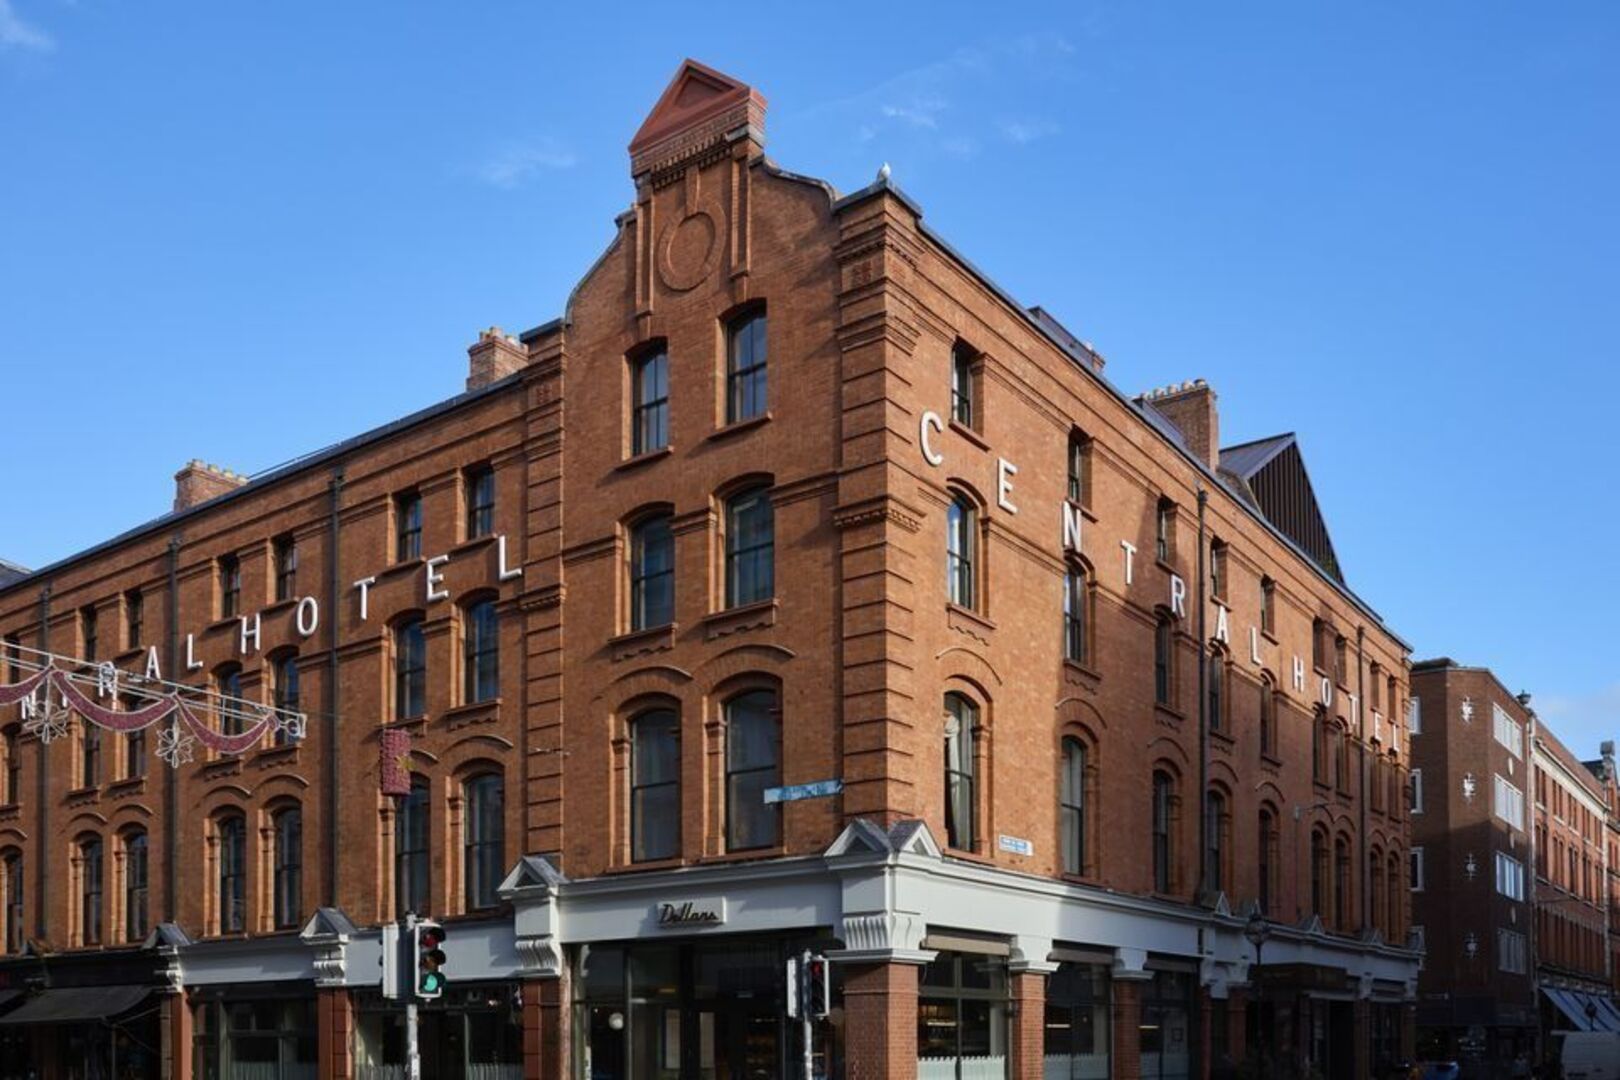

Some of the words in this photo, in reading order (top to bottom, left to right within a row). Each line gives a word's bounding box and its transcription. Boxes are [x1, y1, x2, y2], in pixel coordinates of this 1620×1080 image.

[240, 534, 522, 654] HOTEL
[920, 411, 1263, 665] CENTRAL
[1294, 656, 1400, 752] HOTEL
